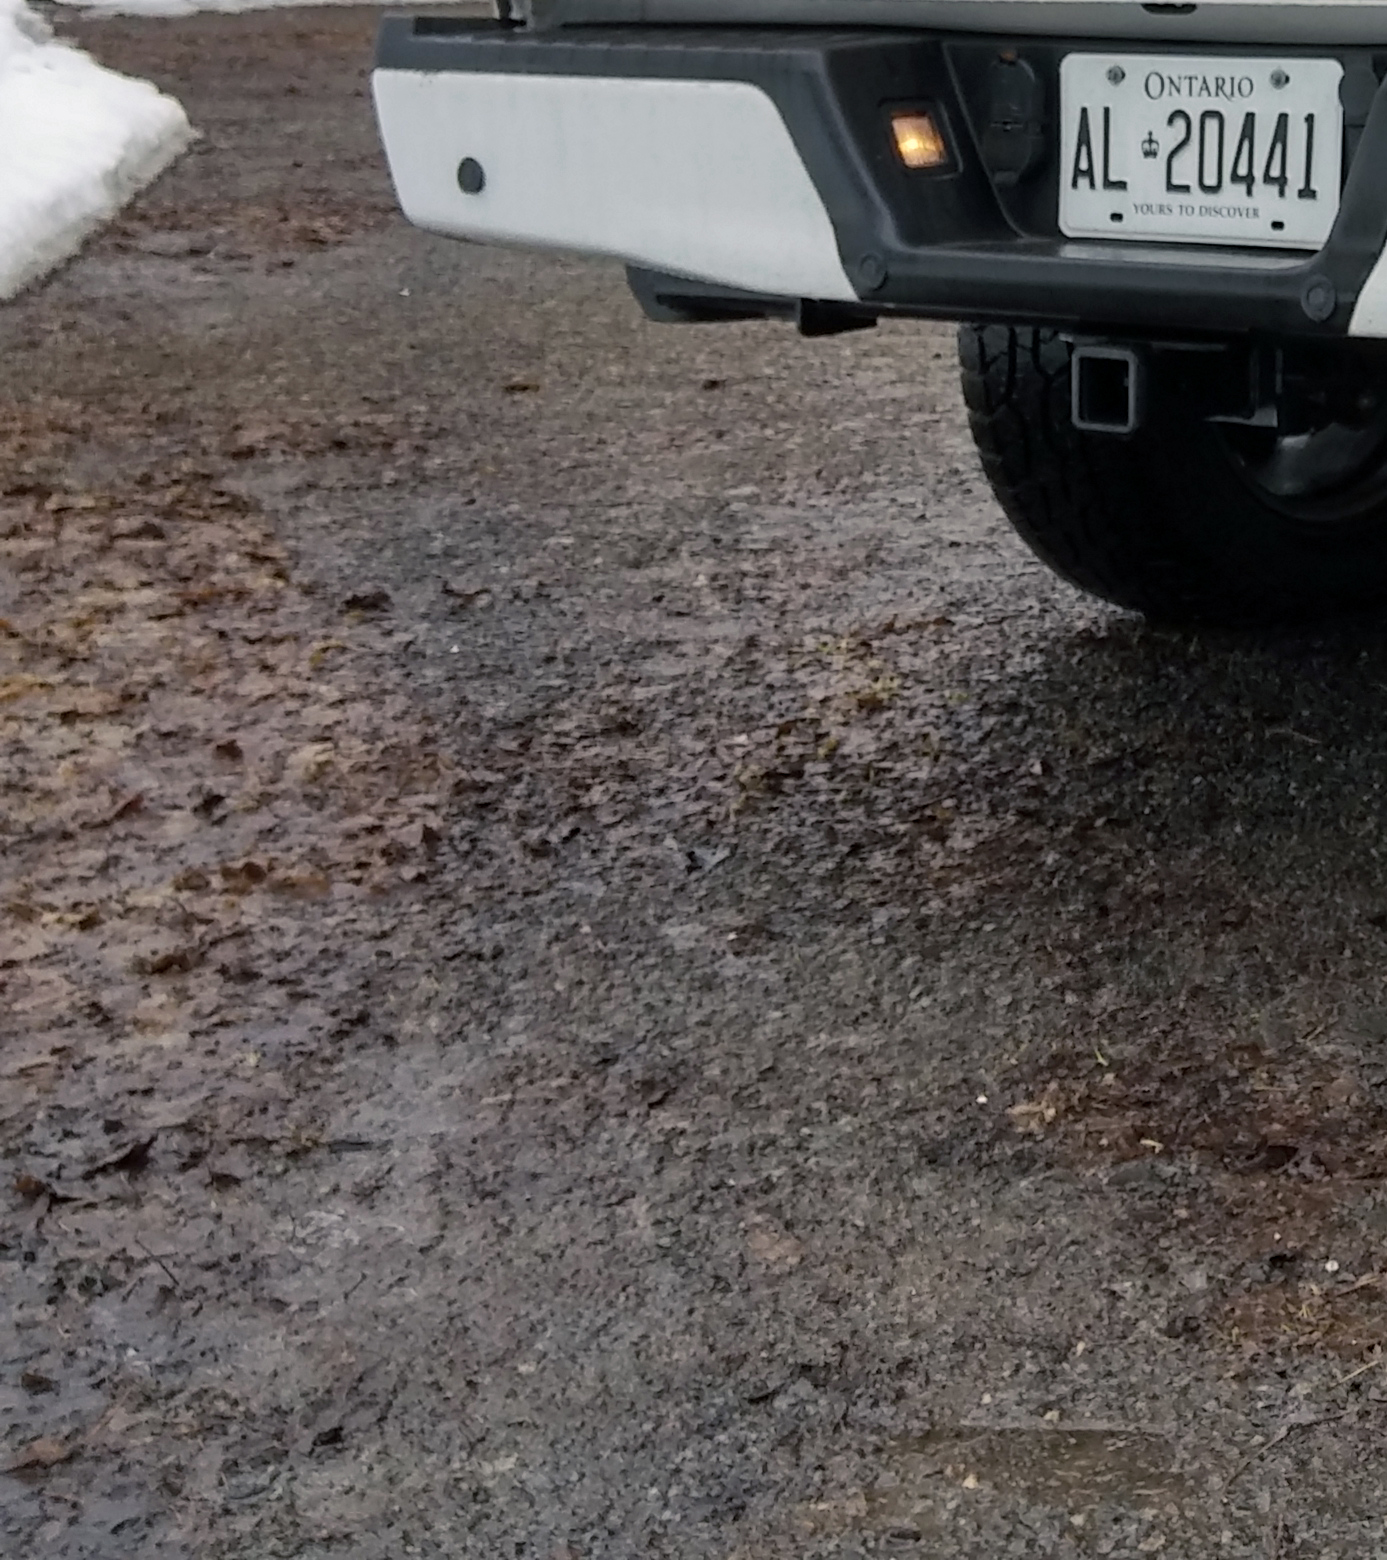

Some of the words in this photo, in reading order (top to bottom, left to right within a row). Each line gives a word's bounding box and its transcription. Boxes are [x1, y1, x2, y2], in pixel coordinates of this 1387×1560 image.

[1071, 106, 1128, 191] AL
[1165, 108, 1318, 200] 20441
[1132, 203, 1173, 216] YOURS
[1178, 204, 1196, 217] TO
[1199, 205, 1260, 219] DISCOVER
